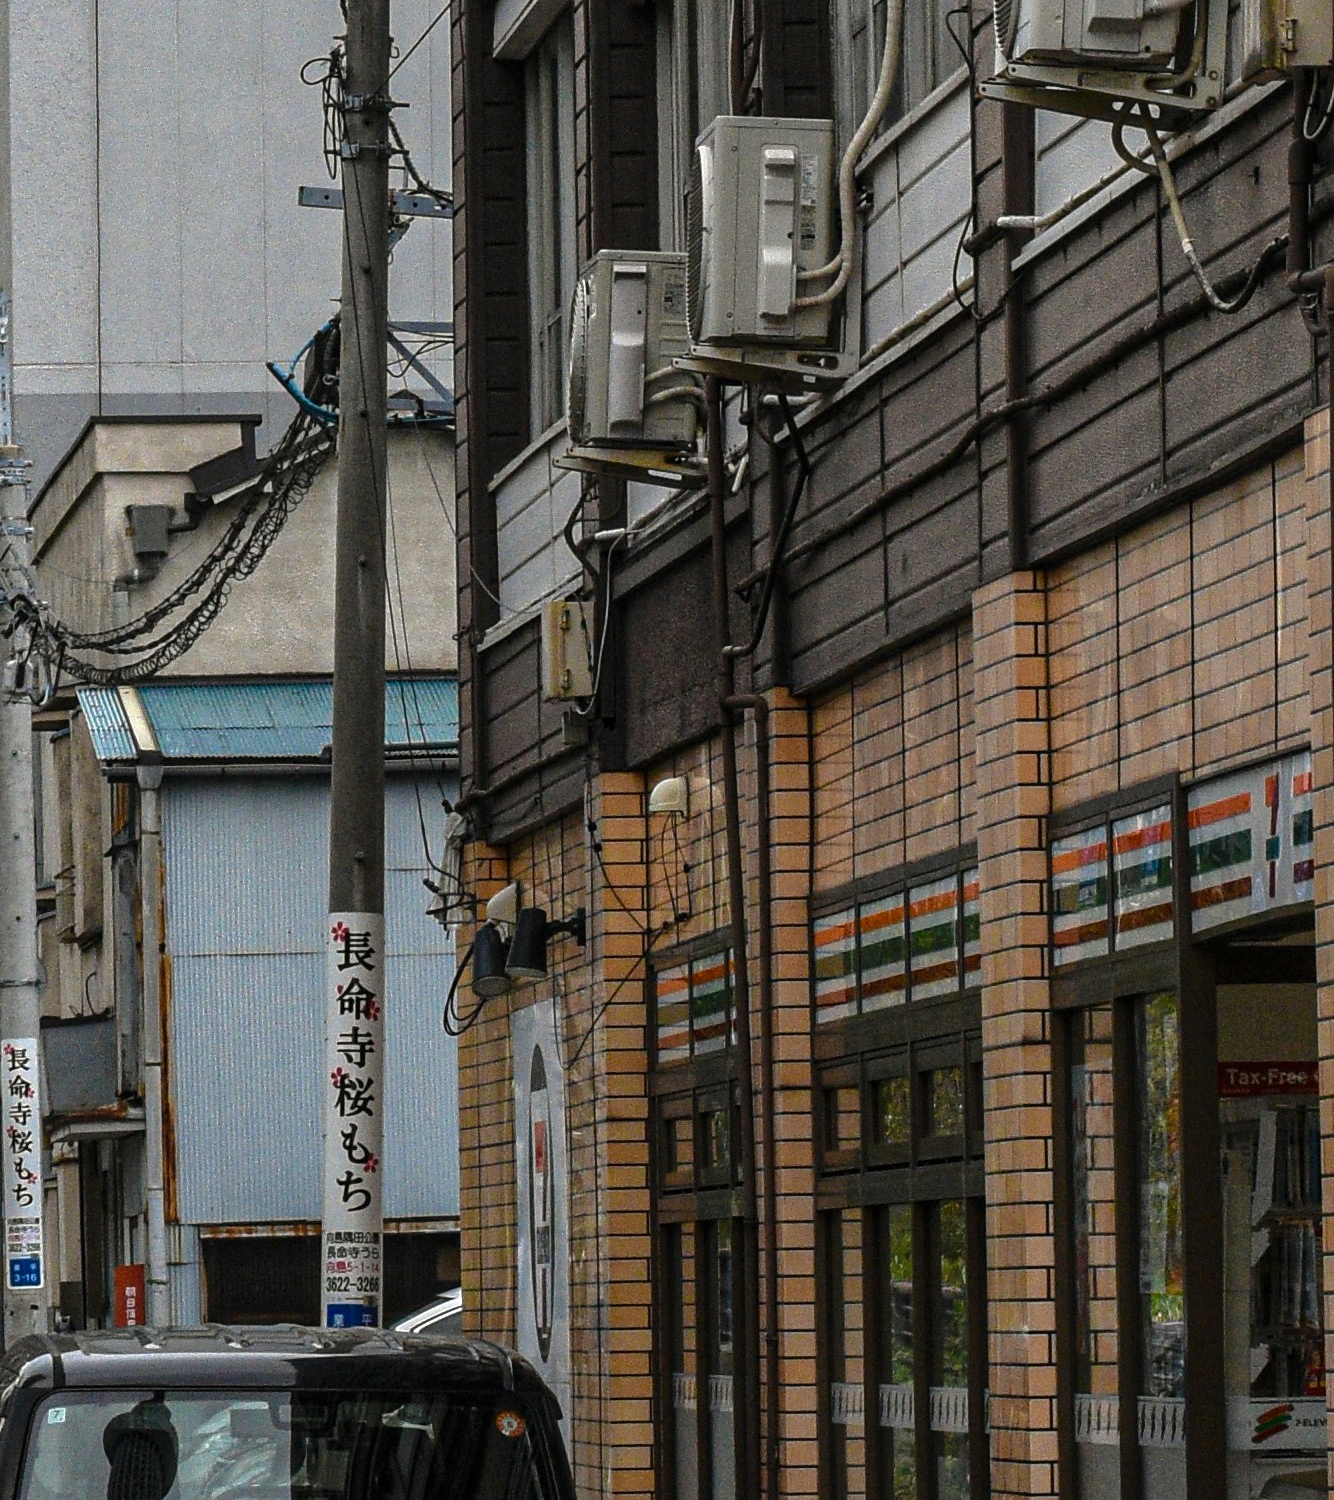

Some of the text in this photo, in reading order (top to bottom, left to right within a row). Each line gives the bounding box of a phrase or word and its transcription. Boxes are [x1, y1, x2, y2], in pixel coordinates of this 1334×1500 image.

[334, 930, 376, 1213] 長命寺桜もち
[1224, 1067, 1309, 1086] Tax-Free
[7, 1048, 34, 1207] 長命寺桜もち
[326, 1276, 379, 1292] 3622-3266
